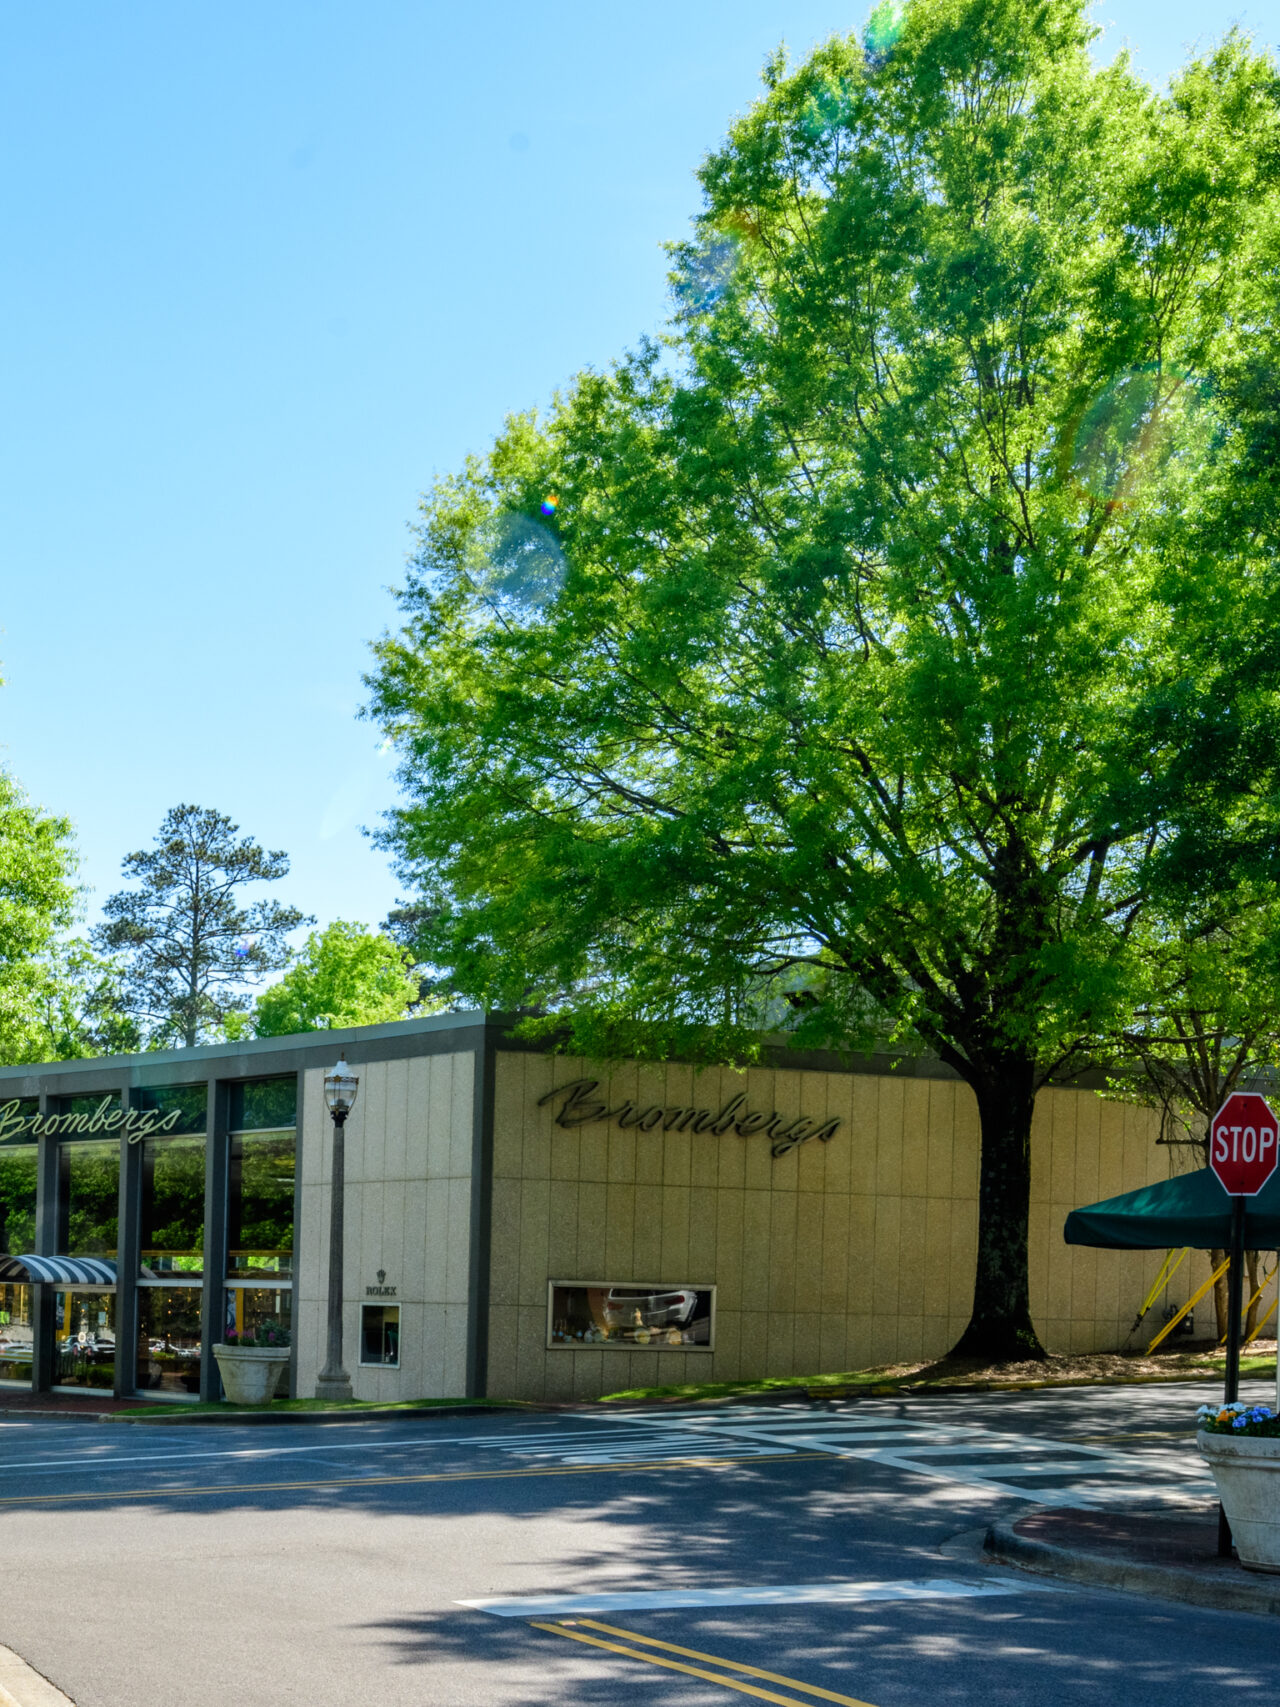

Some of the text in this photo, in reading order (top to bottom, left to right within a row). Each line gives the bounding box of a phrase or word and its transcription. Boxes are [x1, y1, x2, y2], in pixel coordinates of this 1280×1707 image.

[536, 1077, 843, 1159] Brombergs
[1215, 1125, 1274, 1163] STOP
[366, 1286, 397, 1296] ROLEX
